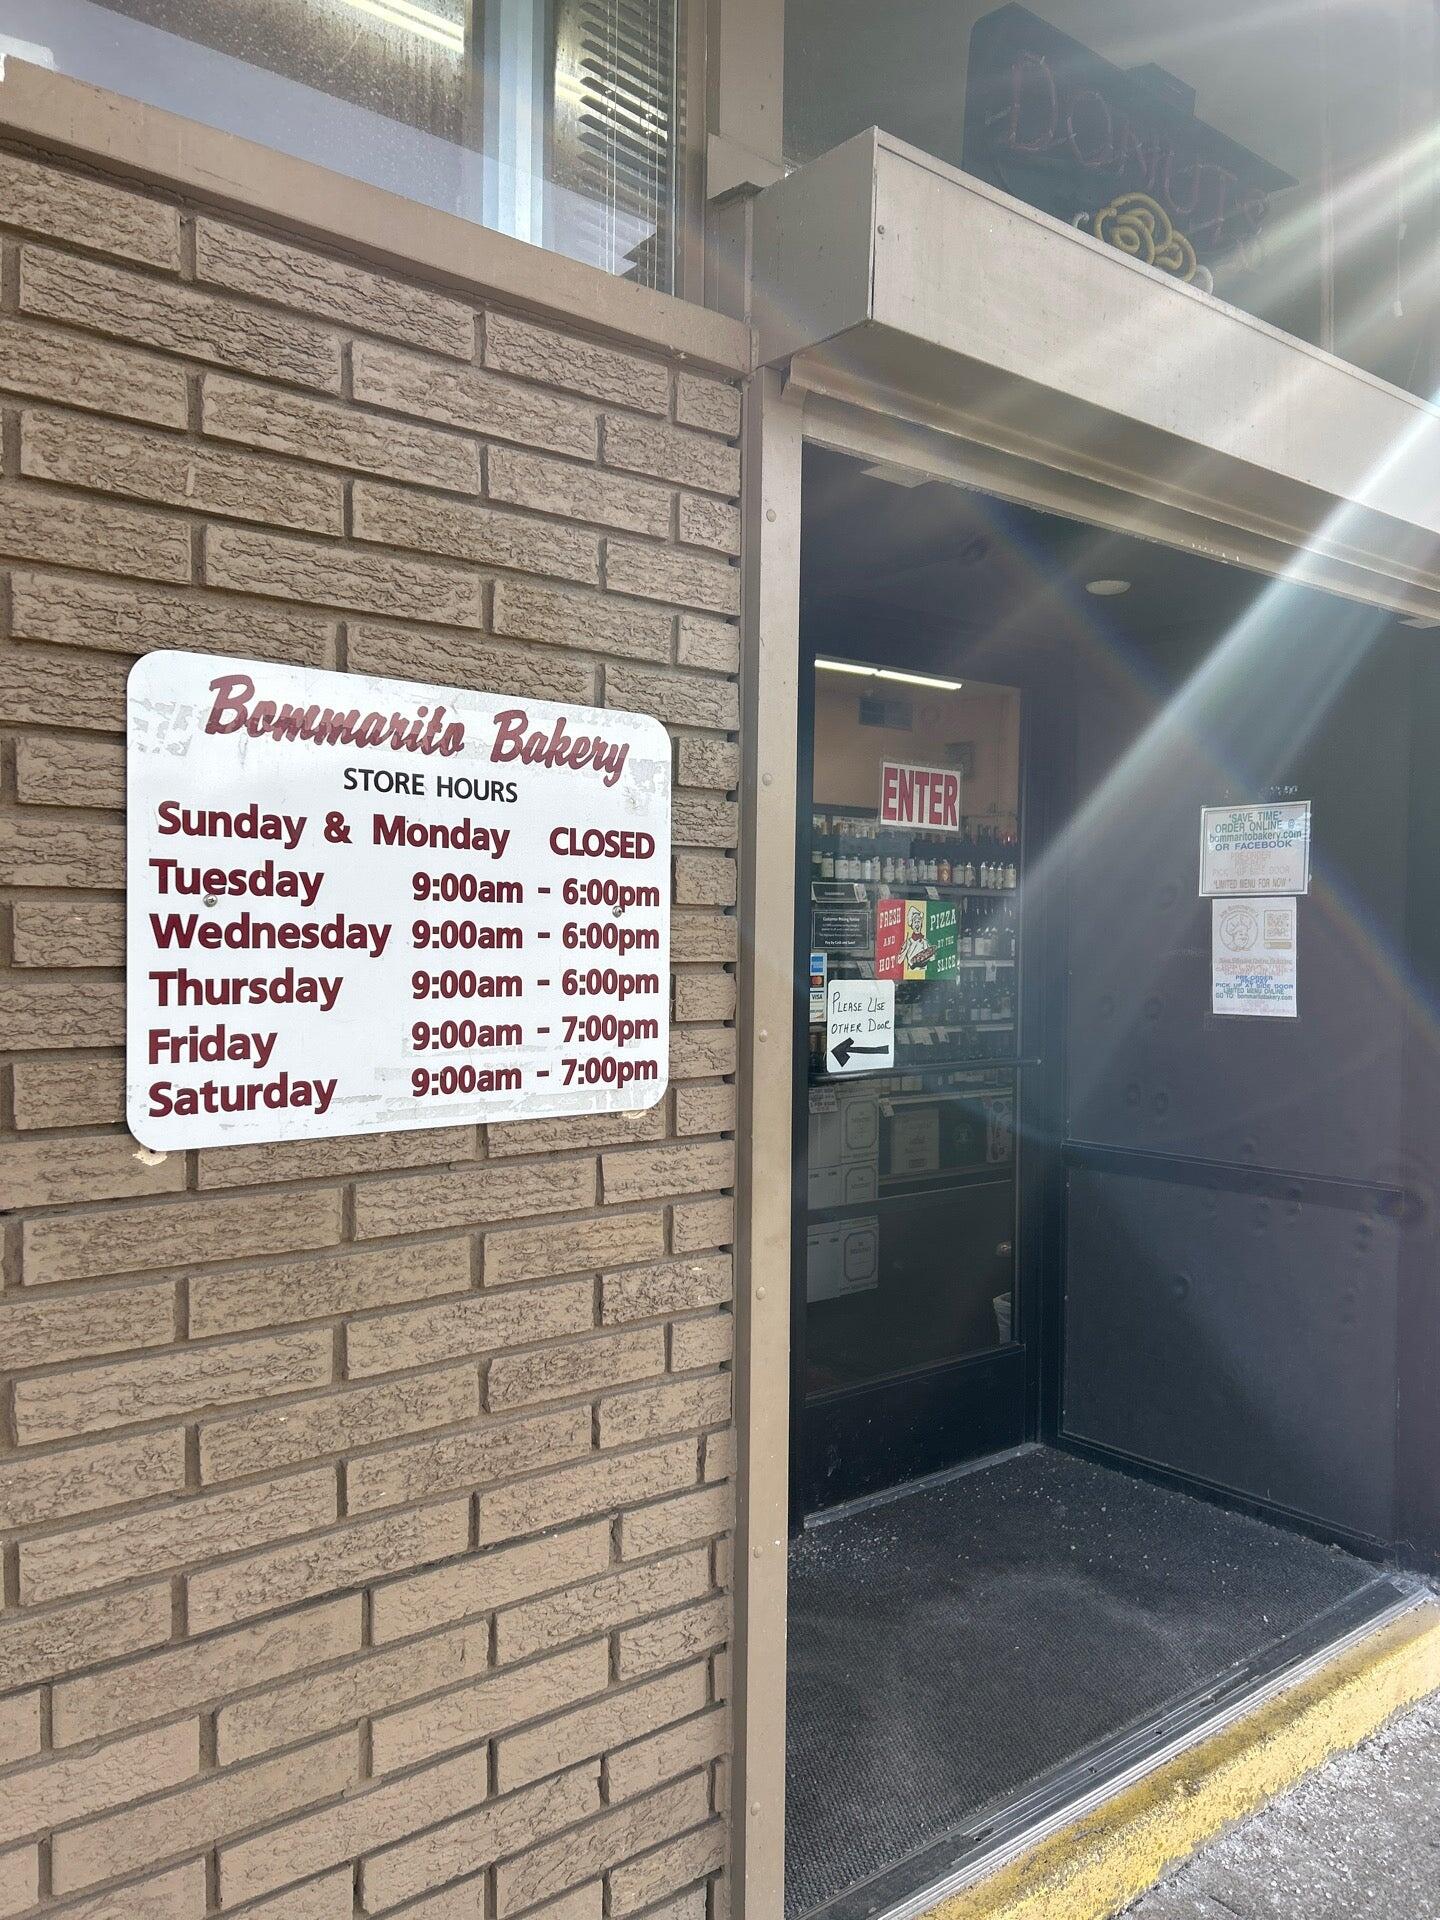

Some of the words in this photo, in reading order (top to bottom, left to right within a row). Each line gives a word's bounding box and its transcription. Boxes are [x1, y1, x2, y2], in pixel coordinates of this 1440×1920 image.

[205, 674, 465, 757] Bommarito
[490, 709, 630, 787] Bakery
[343, 767, 425, 795] STORE
[437, 775, 518, 802] HOURS
[883, 767, 958, 826] ENTER
[158, 800, 307, 849] Sunday
[323, 811, 353, 844] &
[373, 813, 510, 859] Monday
[549, 826, 656, 859] CLOSED
[1215, 823, 1245, 833] ORDER
[1249, 820, 1282, 831] ONLINE
[1215, 843, 1230, 851] OR
[1235, 839, 1293, 850] FACEBOOK
[149, 858, 325, 907] Tuesday
[412, 871, 523, 903] 9:00am
[562, 877, 660, 913] 6:00pm
[149, 912, 392, 957] Wednesday
[412, 920, 523, 949] 9:00am
[562, 922, 660, 956] 6:00pm
[879, 908, 902, 929] FRESH
[930, 908, 957, 931] PIZZA
[883, 936, 896, 947] AND
[879, 956, 896, 972] HOT
[937, 955, 956, 973] SLICE
[149, 967, 343, 1011] Thursday
[412, 970, 523, 999] 9:00am
[562, 968, 659, 1001] 6:00pm
[149, 1024, 278, 1069] Friday
[412, 1020, 523, 1050] 9:00am
[562, 1015, 659, 1047] 7:00pm
[149, 1071, 338, 1118] Saturday
[412, 1065, 522, 1097] 9:00am
[562, 1056, 658, 1089] 7:00pm
